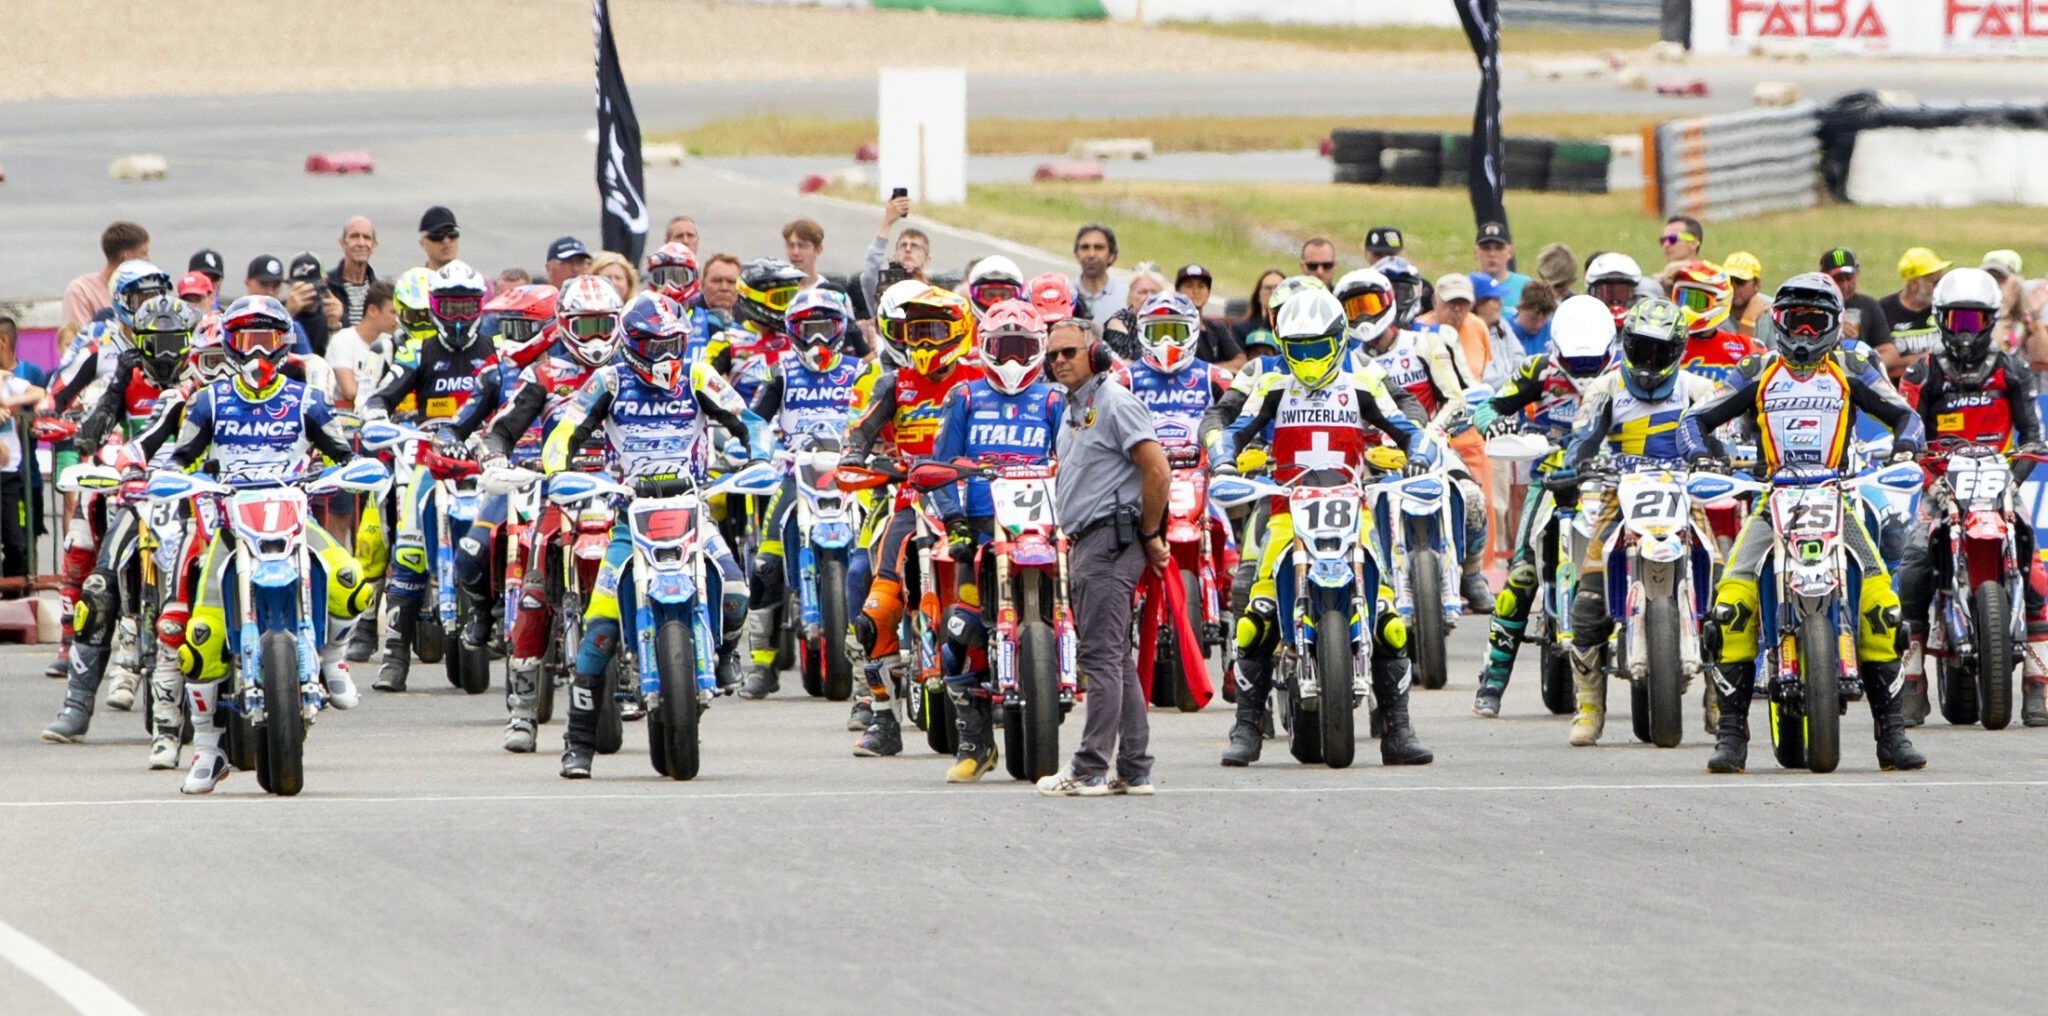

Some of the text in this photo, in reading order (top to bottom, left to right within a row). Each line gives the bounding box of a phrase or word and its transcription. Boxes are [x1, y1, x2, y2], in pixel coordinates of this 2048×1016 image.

[435, 376, 475, 391] DMS
[785, 387, 856, 402] FRANCE
[1134, 389, 1206, 404] FRANCE
[1764, 397, 1845, 411] BELGIUM
[613, 400, 695, 416] FRANCE
[1281, 409, 1358, 424] SWITZERLAND
[214, 420, 299, 437] FRANCE
[969, 424, 1047, 448] ITALIA
[1954, 471, 2006, 499] 66
[153, 501, 180, 527] 3
[1631, 490, 1682, 519] 21
[263, 502, 280, 531] 1
[1301, 500, 1351, 530] 18
[1783, 504, 1834, 530] 25
